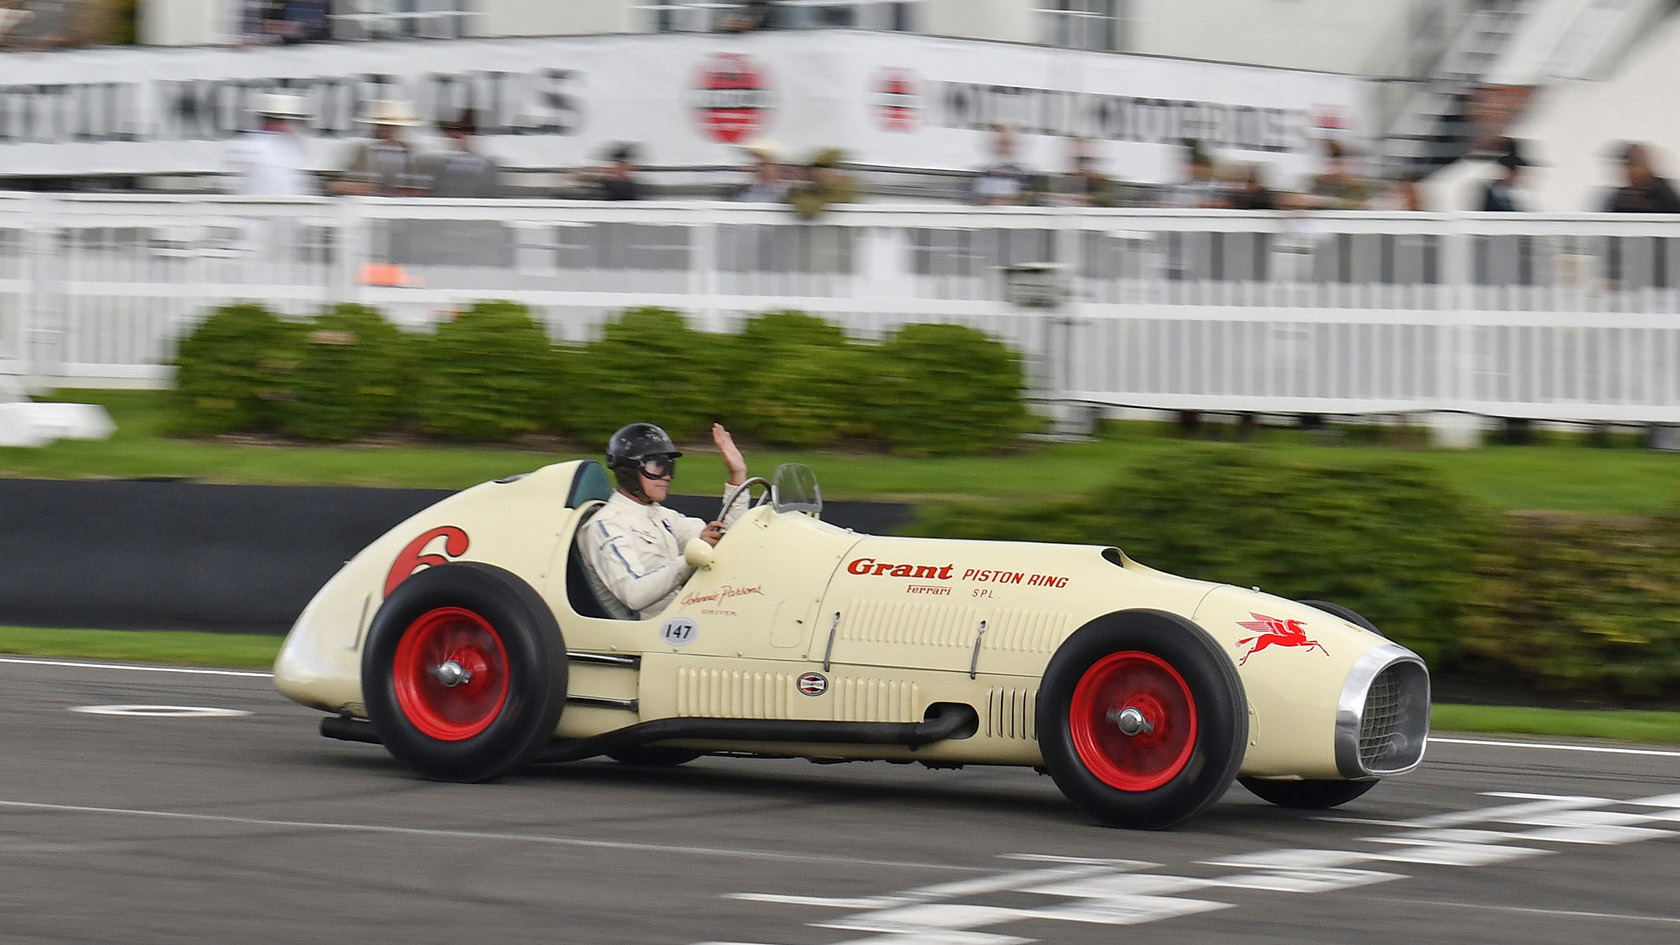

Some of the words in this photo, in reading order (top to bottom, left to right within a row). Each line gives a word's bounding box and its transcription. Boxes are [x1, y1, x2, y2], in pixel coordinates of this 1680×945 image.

[847, 557, 954, 580] Grant
[961, 568, 1025, 586] PISTON
[1027, 573, 1070, 590] RING
[906, 584, 952, 597] Ferrari
[701, 609, 738, 617] DRIVER
[665, 624, 693, 640] 147
